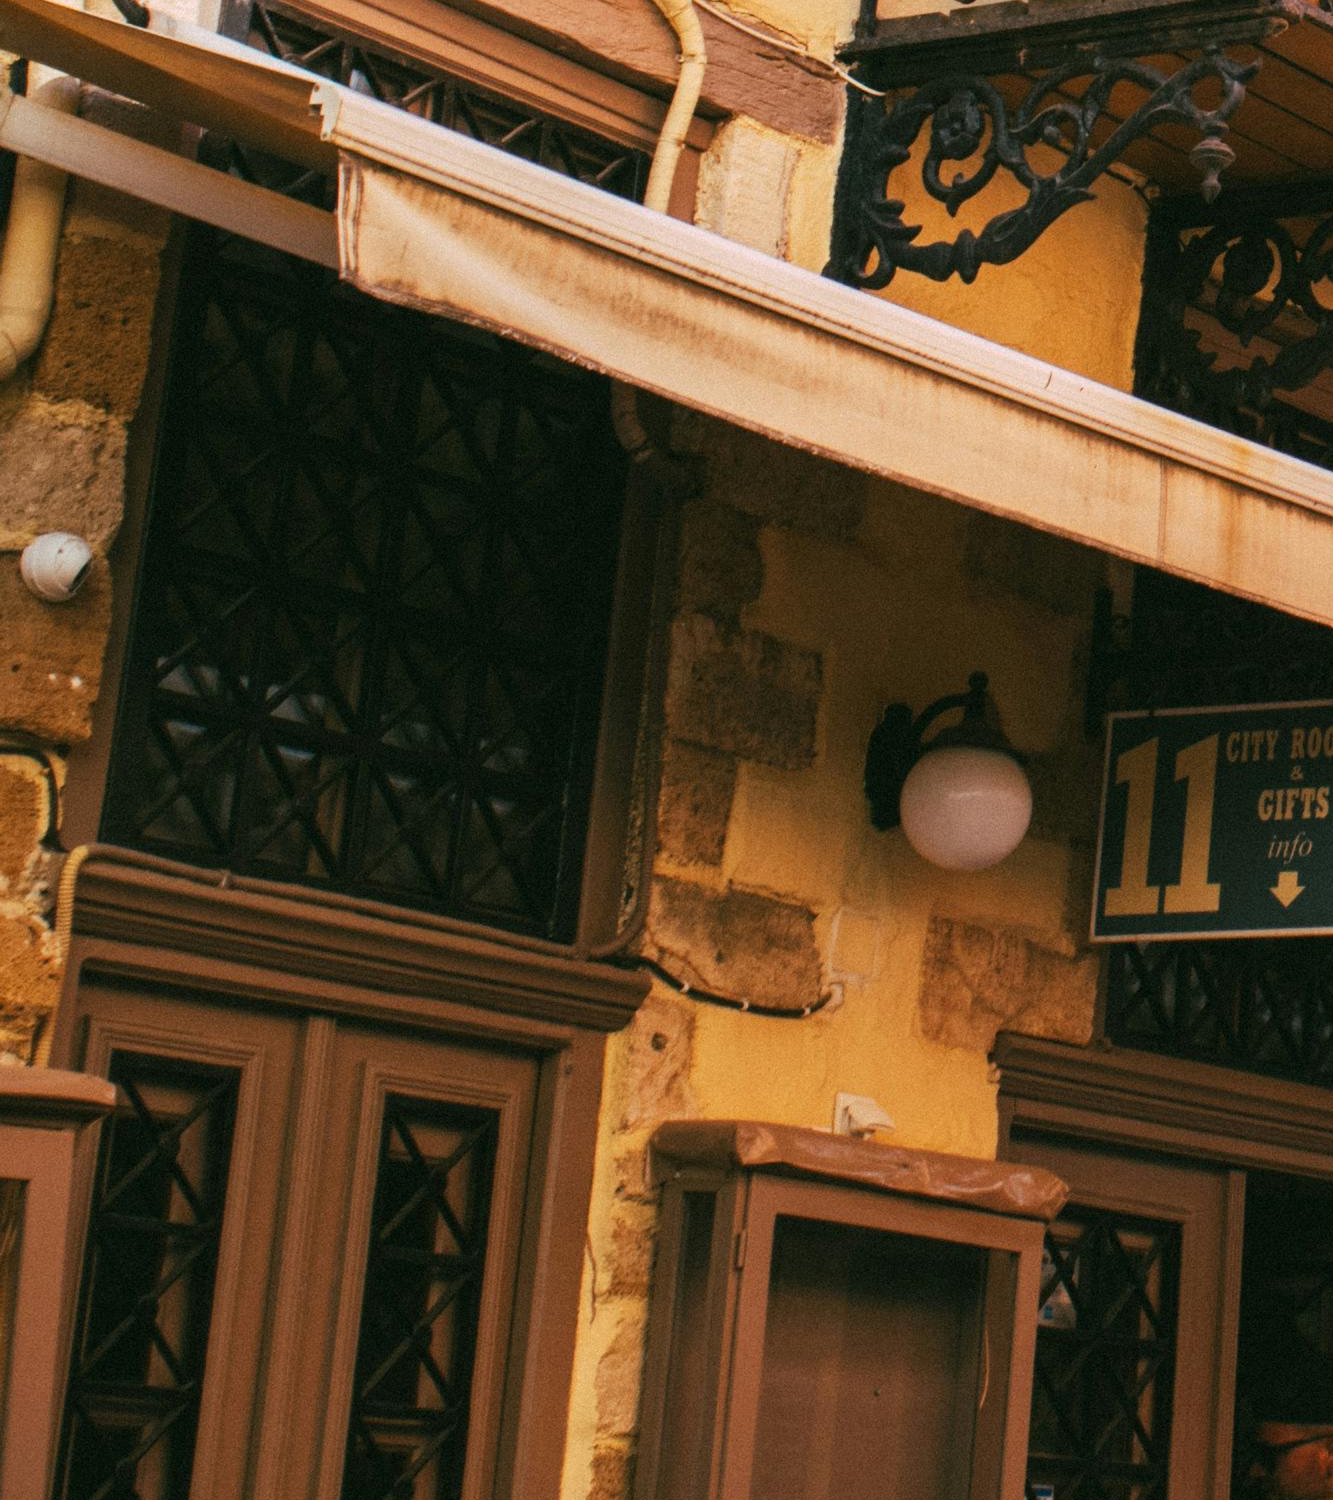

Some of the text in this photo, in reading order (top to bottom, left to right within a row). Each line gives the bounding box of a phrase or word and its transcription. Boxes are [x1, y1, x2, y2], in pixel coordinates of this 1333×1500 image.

[1226, 730, 1279, 762] CITY
[1290, 766, 1304, 780] &
[1257, 786, 1330, 821] GIFTS
[1104, 732, 1221, 916] 11
[1268, 831, 1313, 864] info
